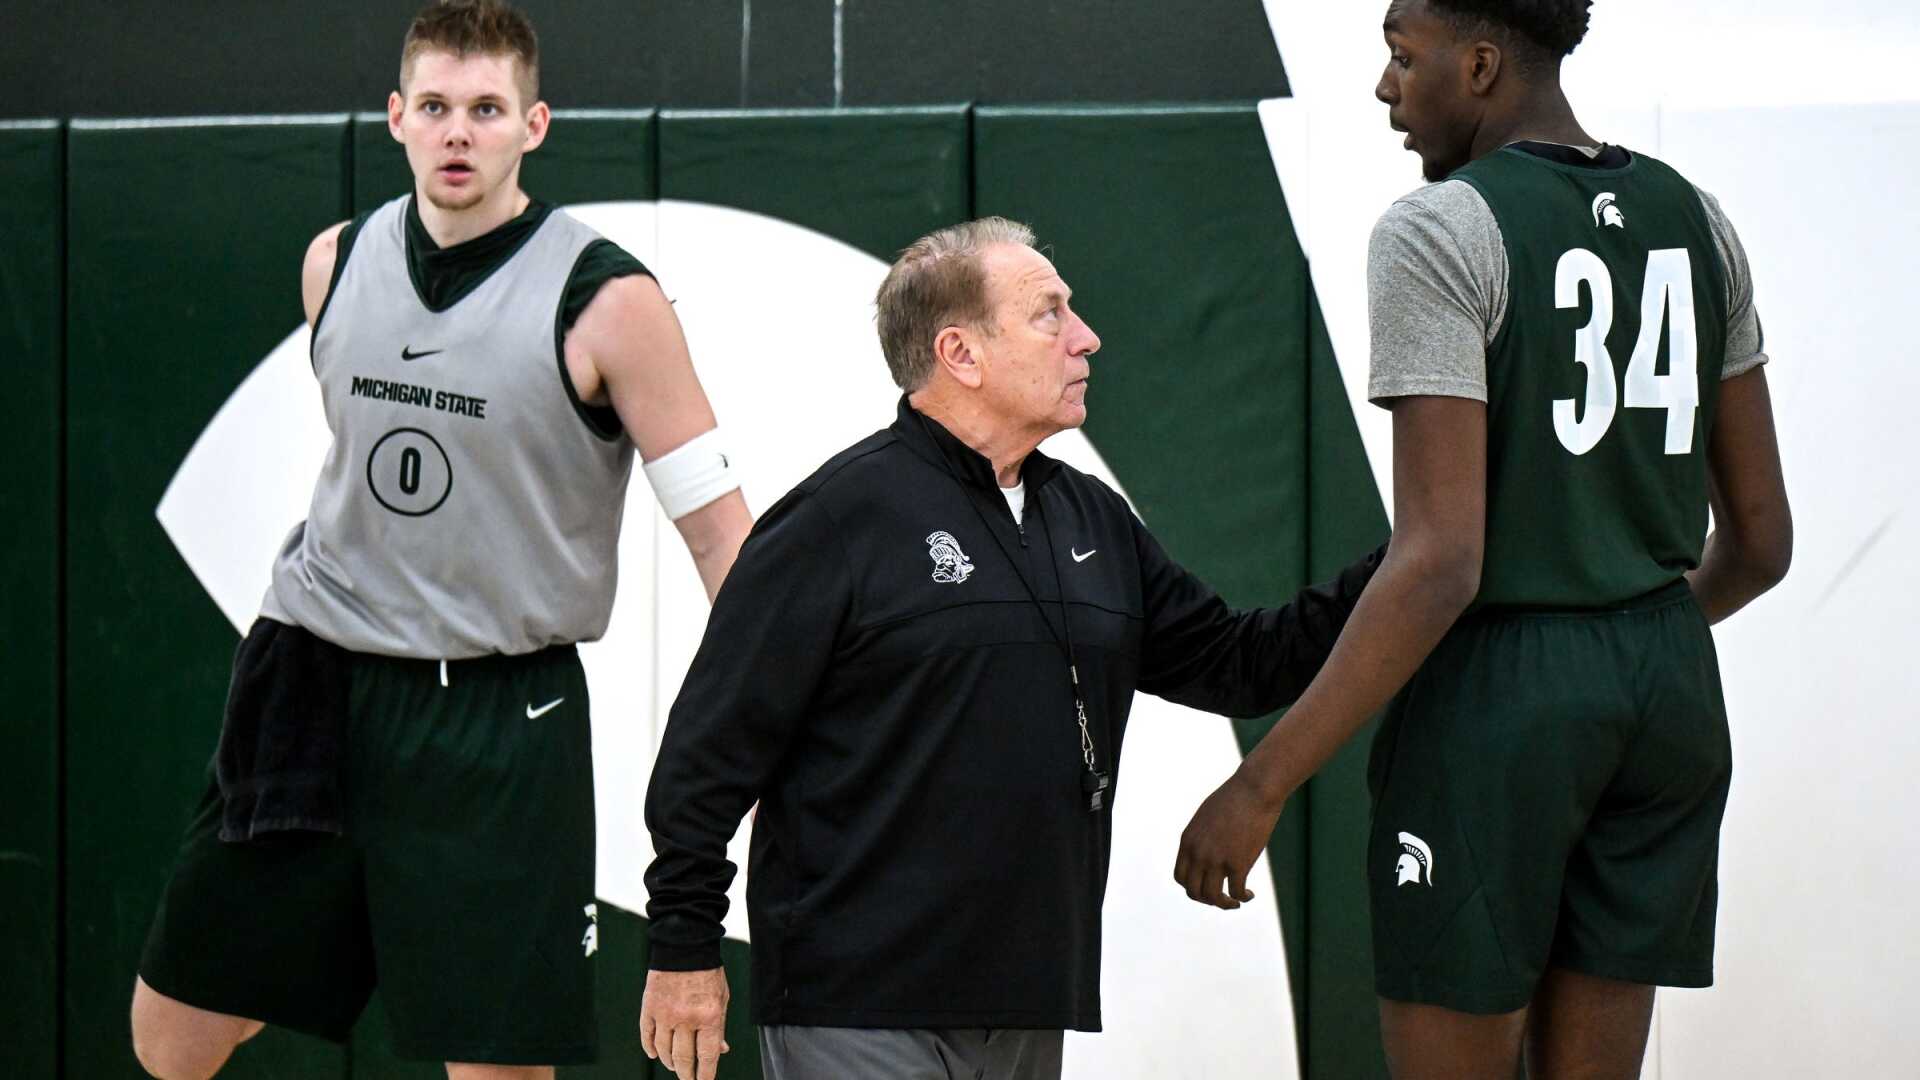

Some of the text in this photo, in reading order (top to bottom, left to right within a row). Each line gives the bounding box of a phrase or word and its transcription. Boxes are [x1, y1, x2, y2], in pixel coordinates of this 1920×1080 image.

[1552, 247, 1699, 456] 34
[350, 376, 487, 419] MICHIGAN STATE
[399, 447, 421, 495] 0
